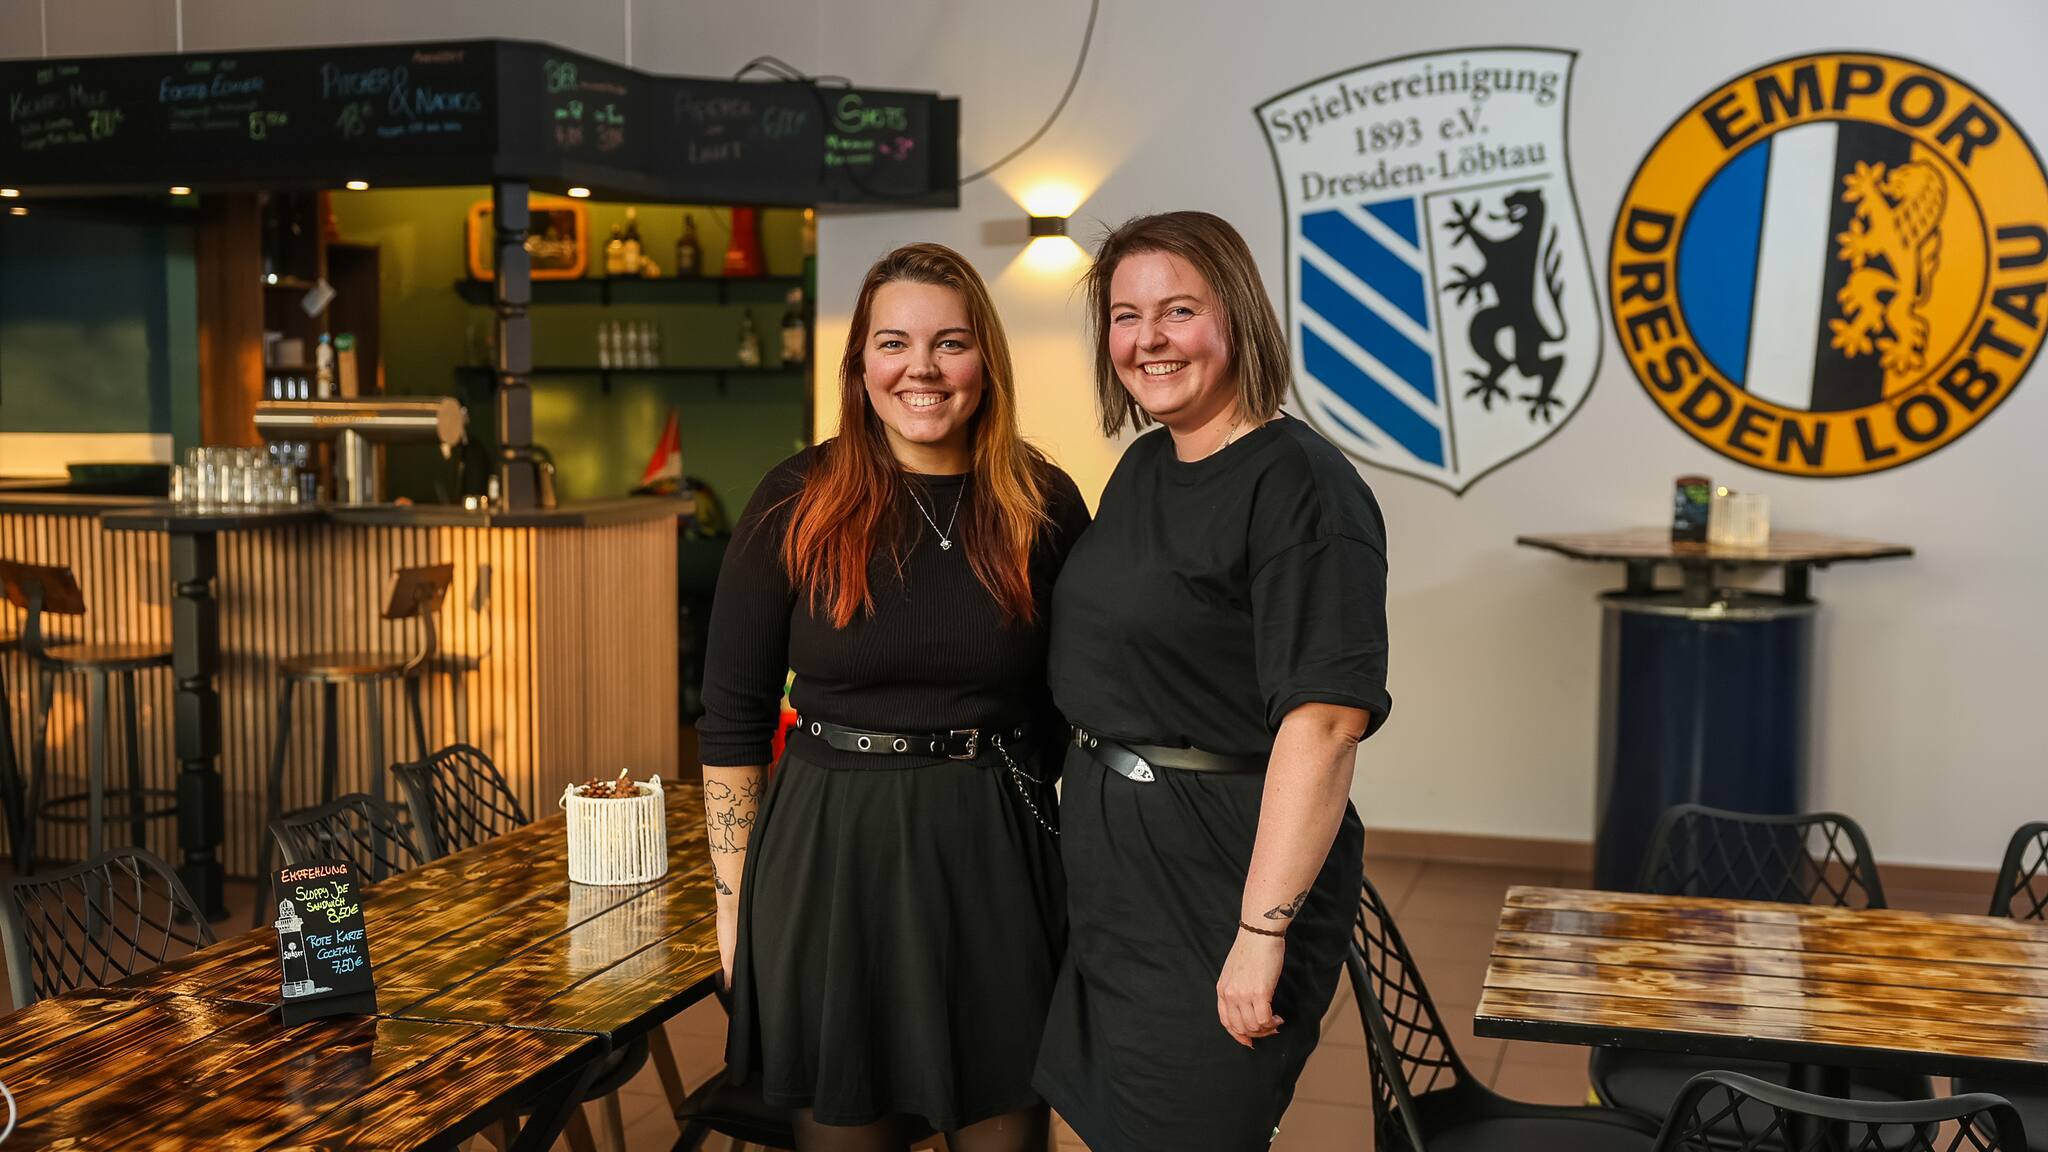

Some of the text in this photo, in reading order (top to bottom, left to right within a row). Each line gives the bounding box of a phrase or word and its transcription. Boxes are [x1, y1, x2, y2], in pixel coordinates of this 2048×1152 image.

[1270, 60, 1561, 145] Spielvereinigung
[1701, 61, 2001, 167] EMPOR
[1354, 105, 1489, 155] 1893 e.V.
[1300, 141, 1547, 202] Dresden-Löbtau
[1617, 207, 1829, 468] DRESDEN
[281, 864, 348, 883] EMPFEHLUNG
[295, 881, 350, 901] SLOPPY JOE
[306, 897, 346, 913] SANDWICH
[326, 903, 359, 924] 8,50€
[306, 929, 364, 949] ROTE KARTE
[316, 945, 357, 960] COCKTAIL
